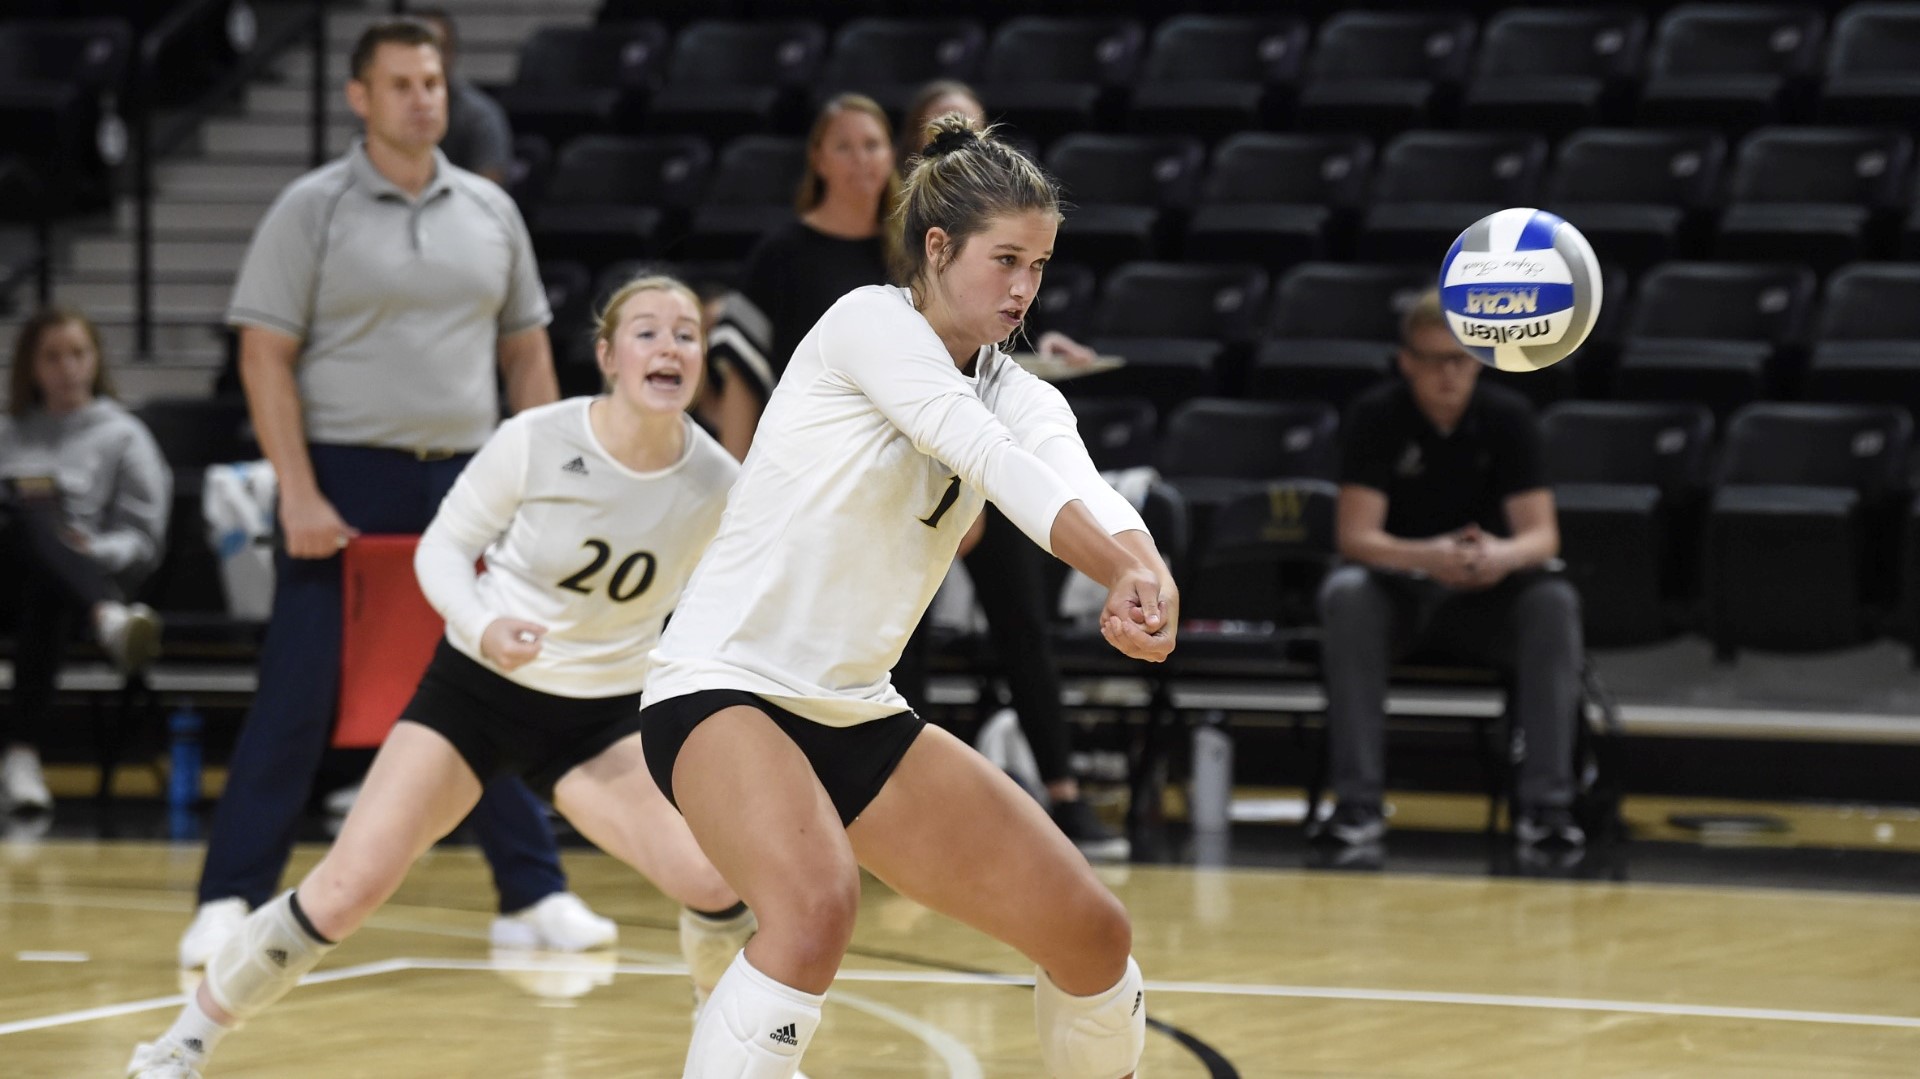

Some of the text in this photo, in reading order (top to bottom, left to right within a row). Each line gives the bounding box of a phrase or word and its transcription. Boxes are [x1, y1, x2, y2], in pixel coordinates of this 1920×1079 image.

[1464, 288, 1538, 314] NCAA
[1463, 319, 1550, 344] molten
[917, 474, 962, 528] 1
[556, 537, 658, 604] 20
[769, 1032, 798, 1046] adidas
